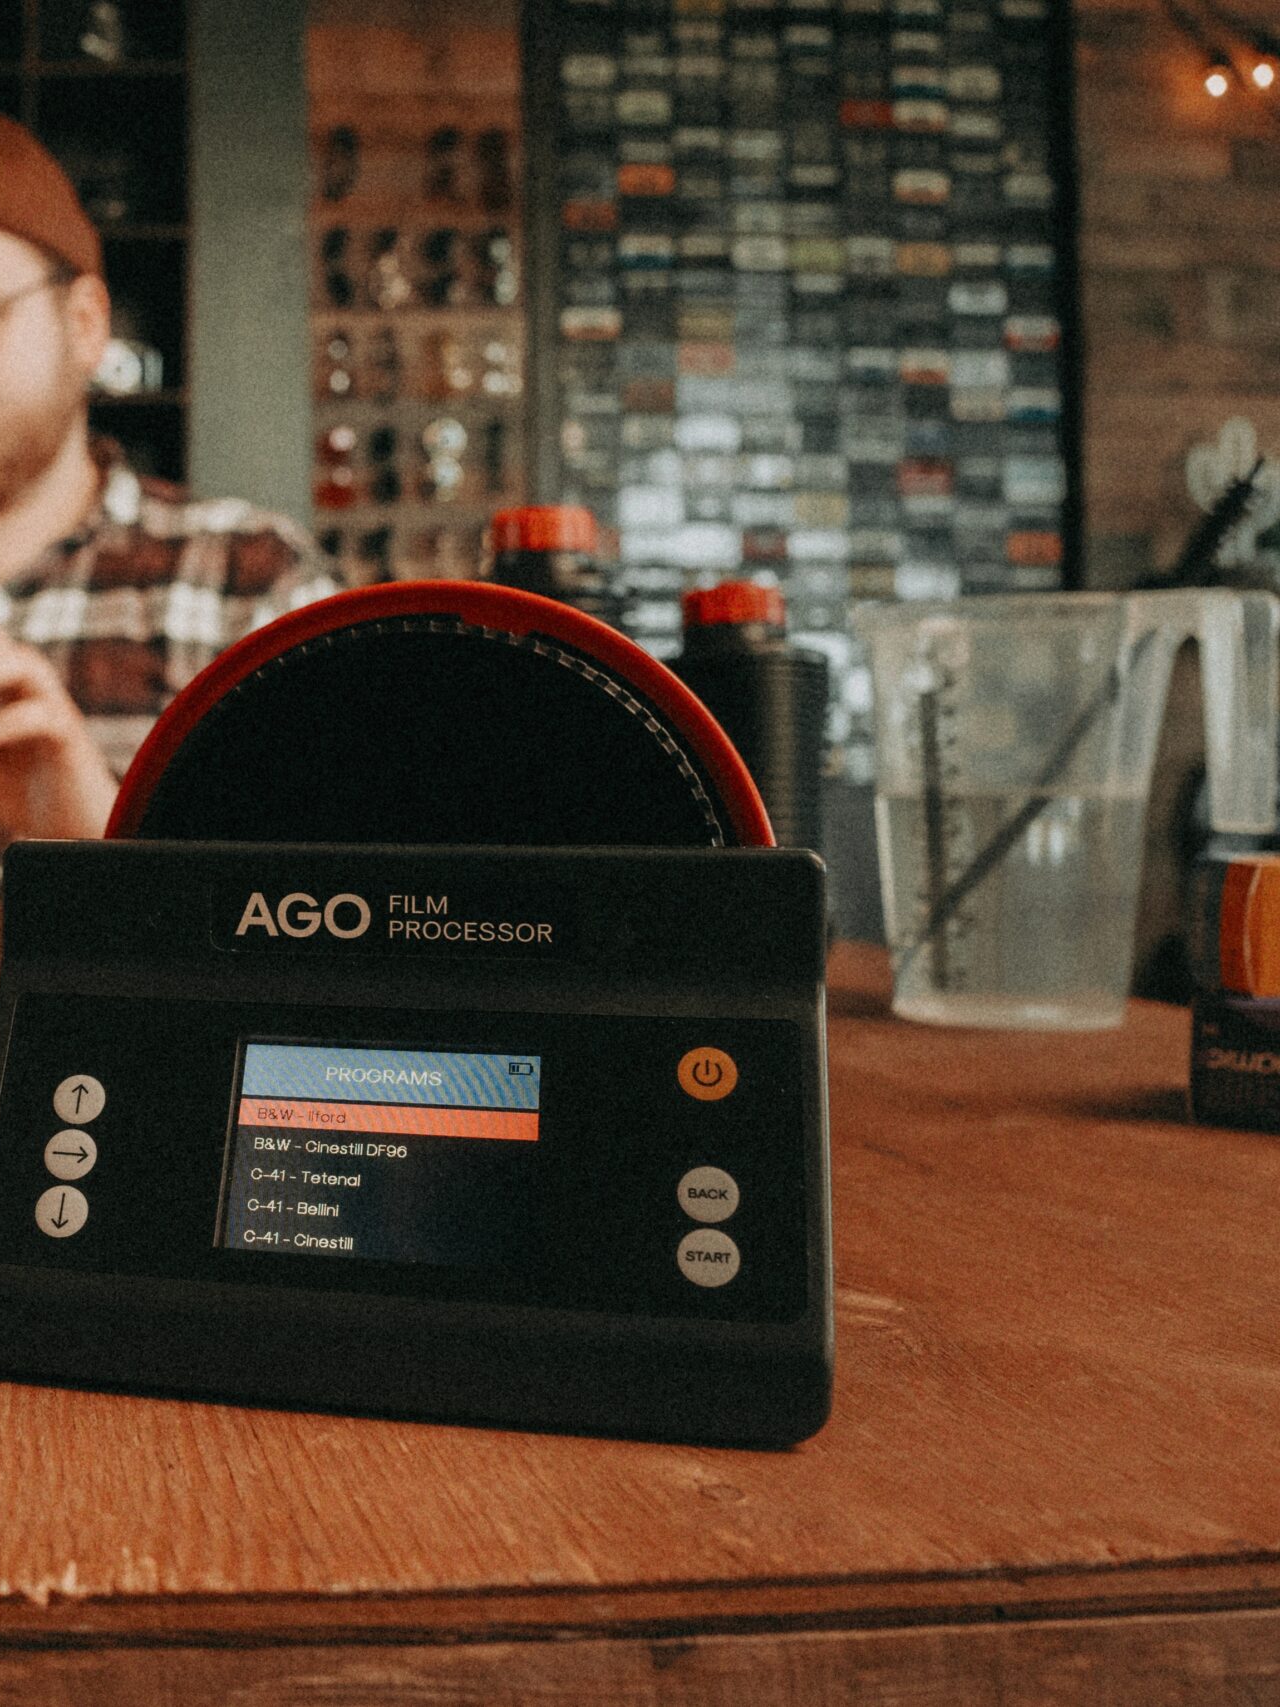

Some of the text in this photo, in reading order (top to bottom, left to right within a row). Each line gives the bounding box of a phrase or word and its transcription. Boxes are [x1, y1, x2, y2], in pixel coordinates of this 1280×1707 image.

[388, 895, 449, 915] FILM
[234, 892, 371, 939] AGO
[388, 920, 554, 944] PROCESSOR
[325, 1066, 443, 1087] PROGRAMS
[257, 1107, 294, 1121] B&W
[253, 1137, 292, 1151] B&W
[305, 1140, 364, 1156] Cinestill
[366, 1144, 408, 1158] DF96
[250, 1167, 286, 1182] C-41
[301, 1170, 361, 1187] Tetenal
[687, 1187, 729, 1201] BACK
[247, 1198, 282, 1213] C-41
[296, 1202, 339, 1217] Bellini
[243, 1229, 279, 1244] C-41
[294, 1233, 354, 1250] Cinestill
[685, 1250, 731, 1265] START
